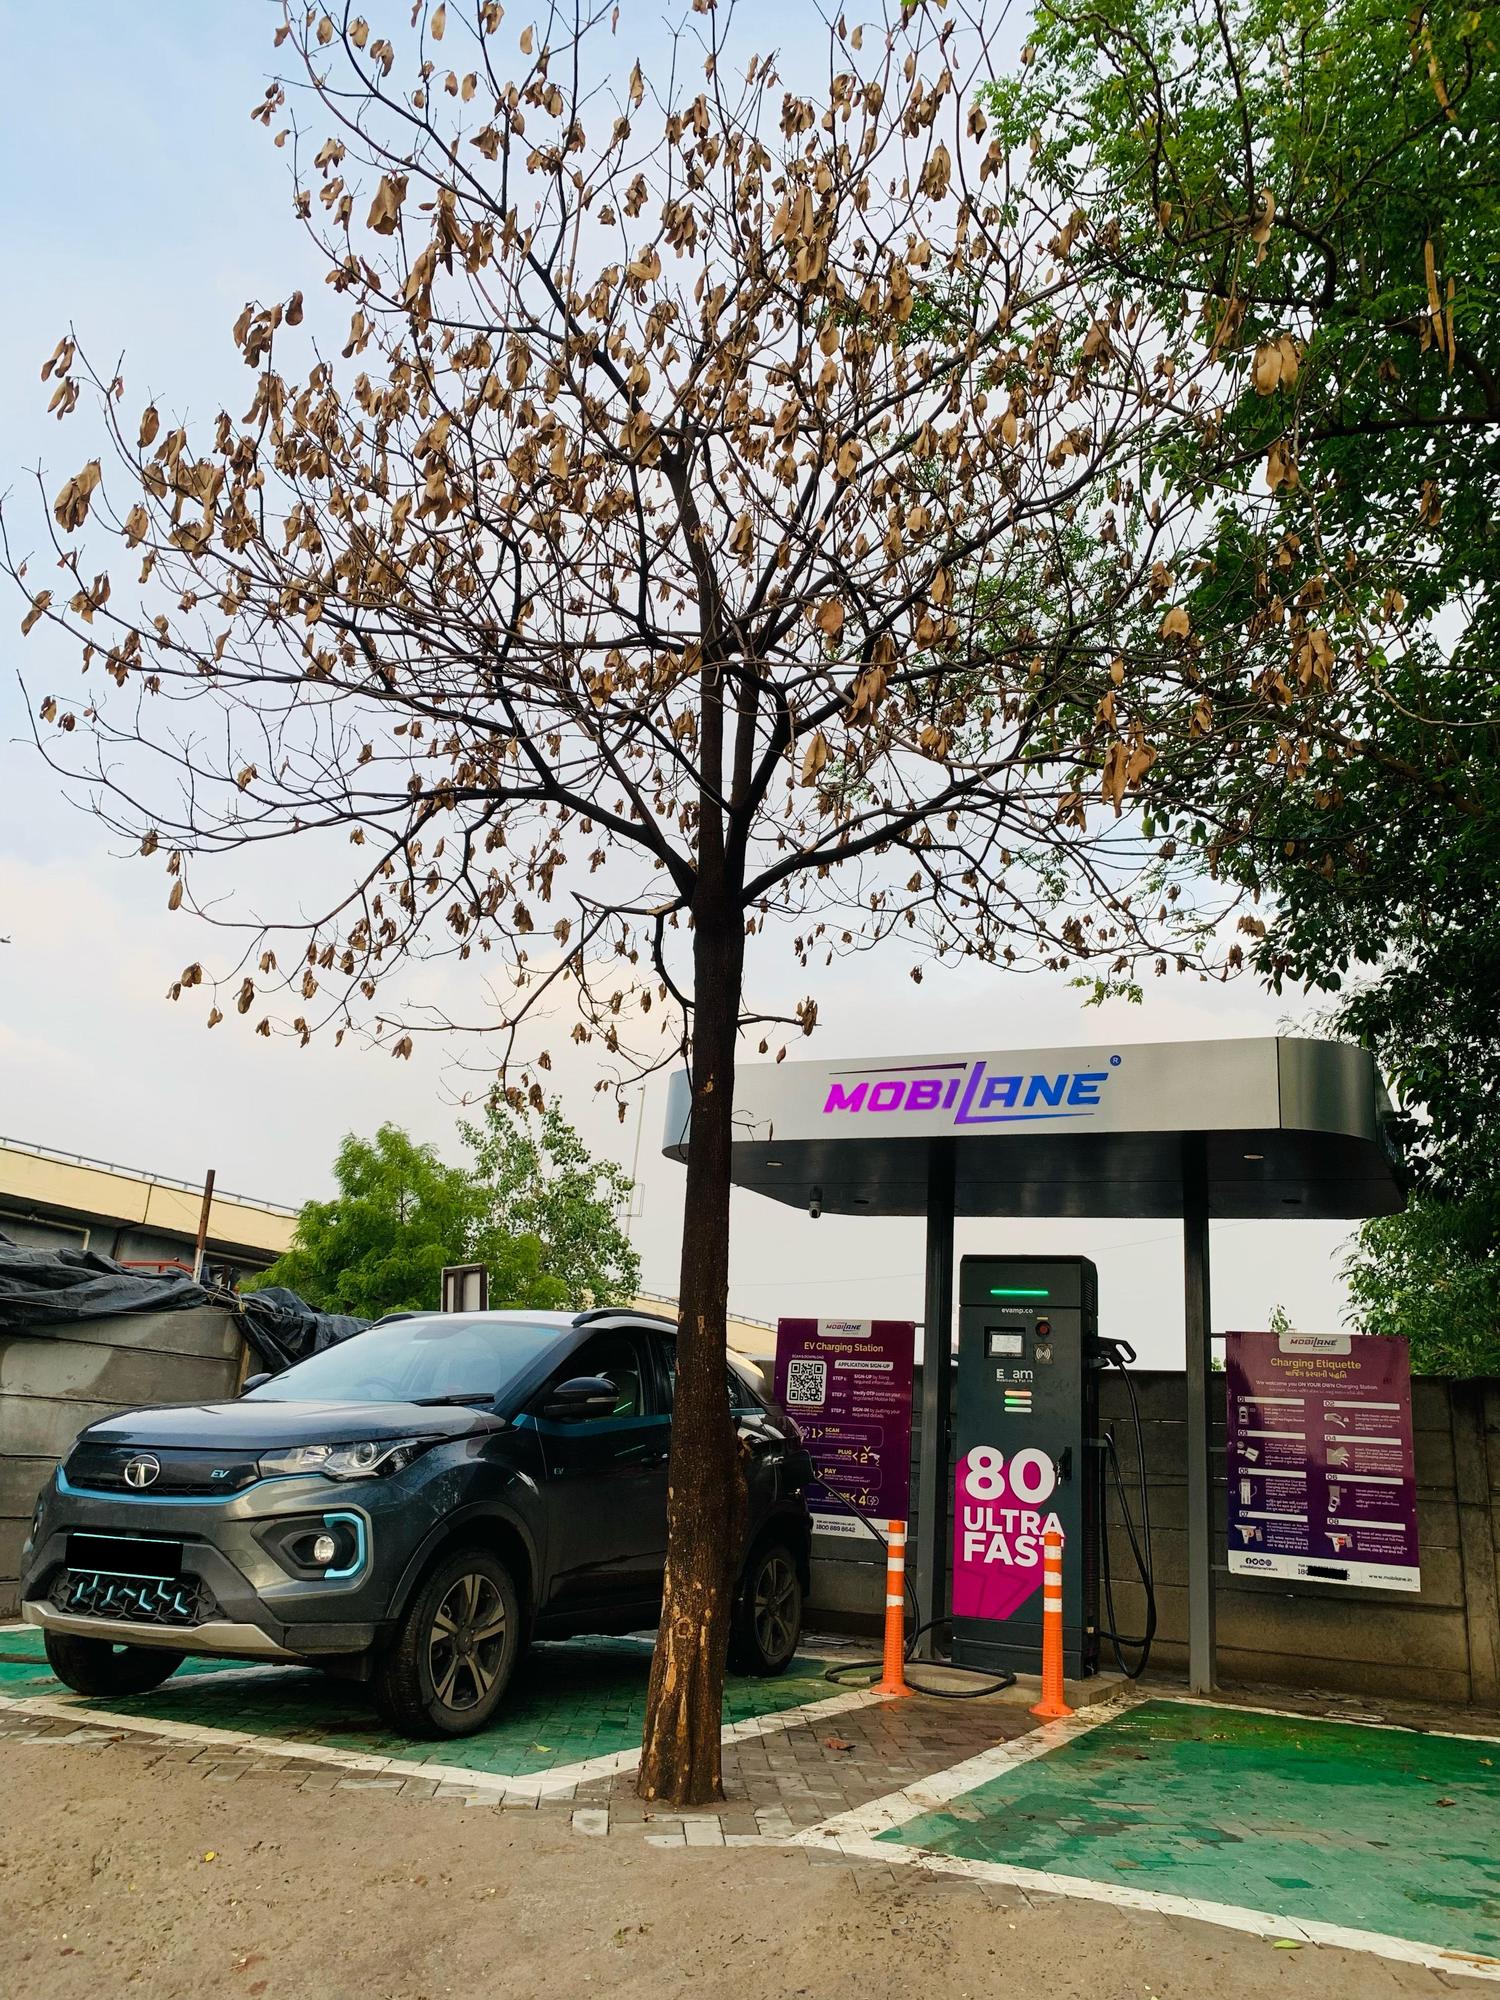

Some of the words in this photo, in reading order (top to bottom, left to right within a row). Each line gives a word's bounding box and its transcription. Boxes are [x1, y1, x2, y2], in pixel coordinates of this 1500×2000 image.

[822, 1061, 1109, 1125] MOBILANE
[826, 1322, 862, 1332] MOBILANE
[1290, 1337, 1338, 1347] MOBILANE
[816, 1342, 852, 1353] Charging
[855, 1344, 883, 1352] Station
[1270, 1358, 1314, 1369] Charging
[1316, 1360, 1361, 1370] Etiquette
[812, 1428, 816, 1438] 1
[860, 1453, 868, 1463] 2
[210, 1470, 230, 1478] EV
[965, 1446, 1056, 1504] 80
[859, 1496, 866, 1505] 4
[964, 1506, 1065, 1538] ULTRA
